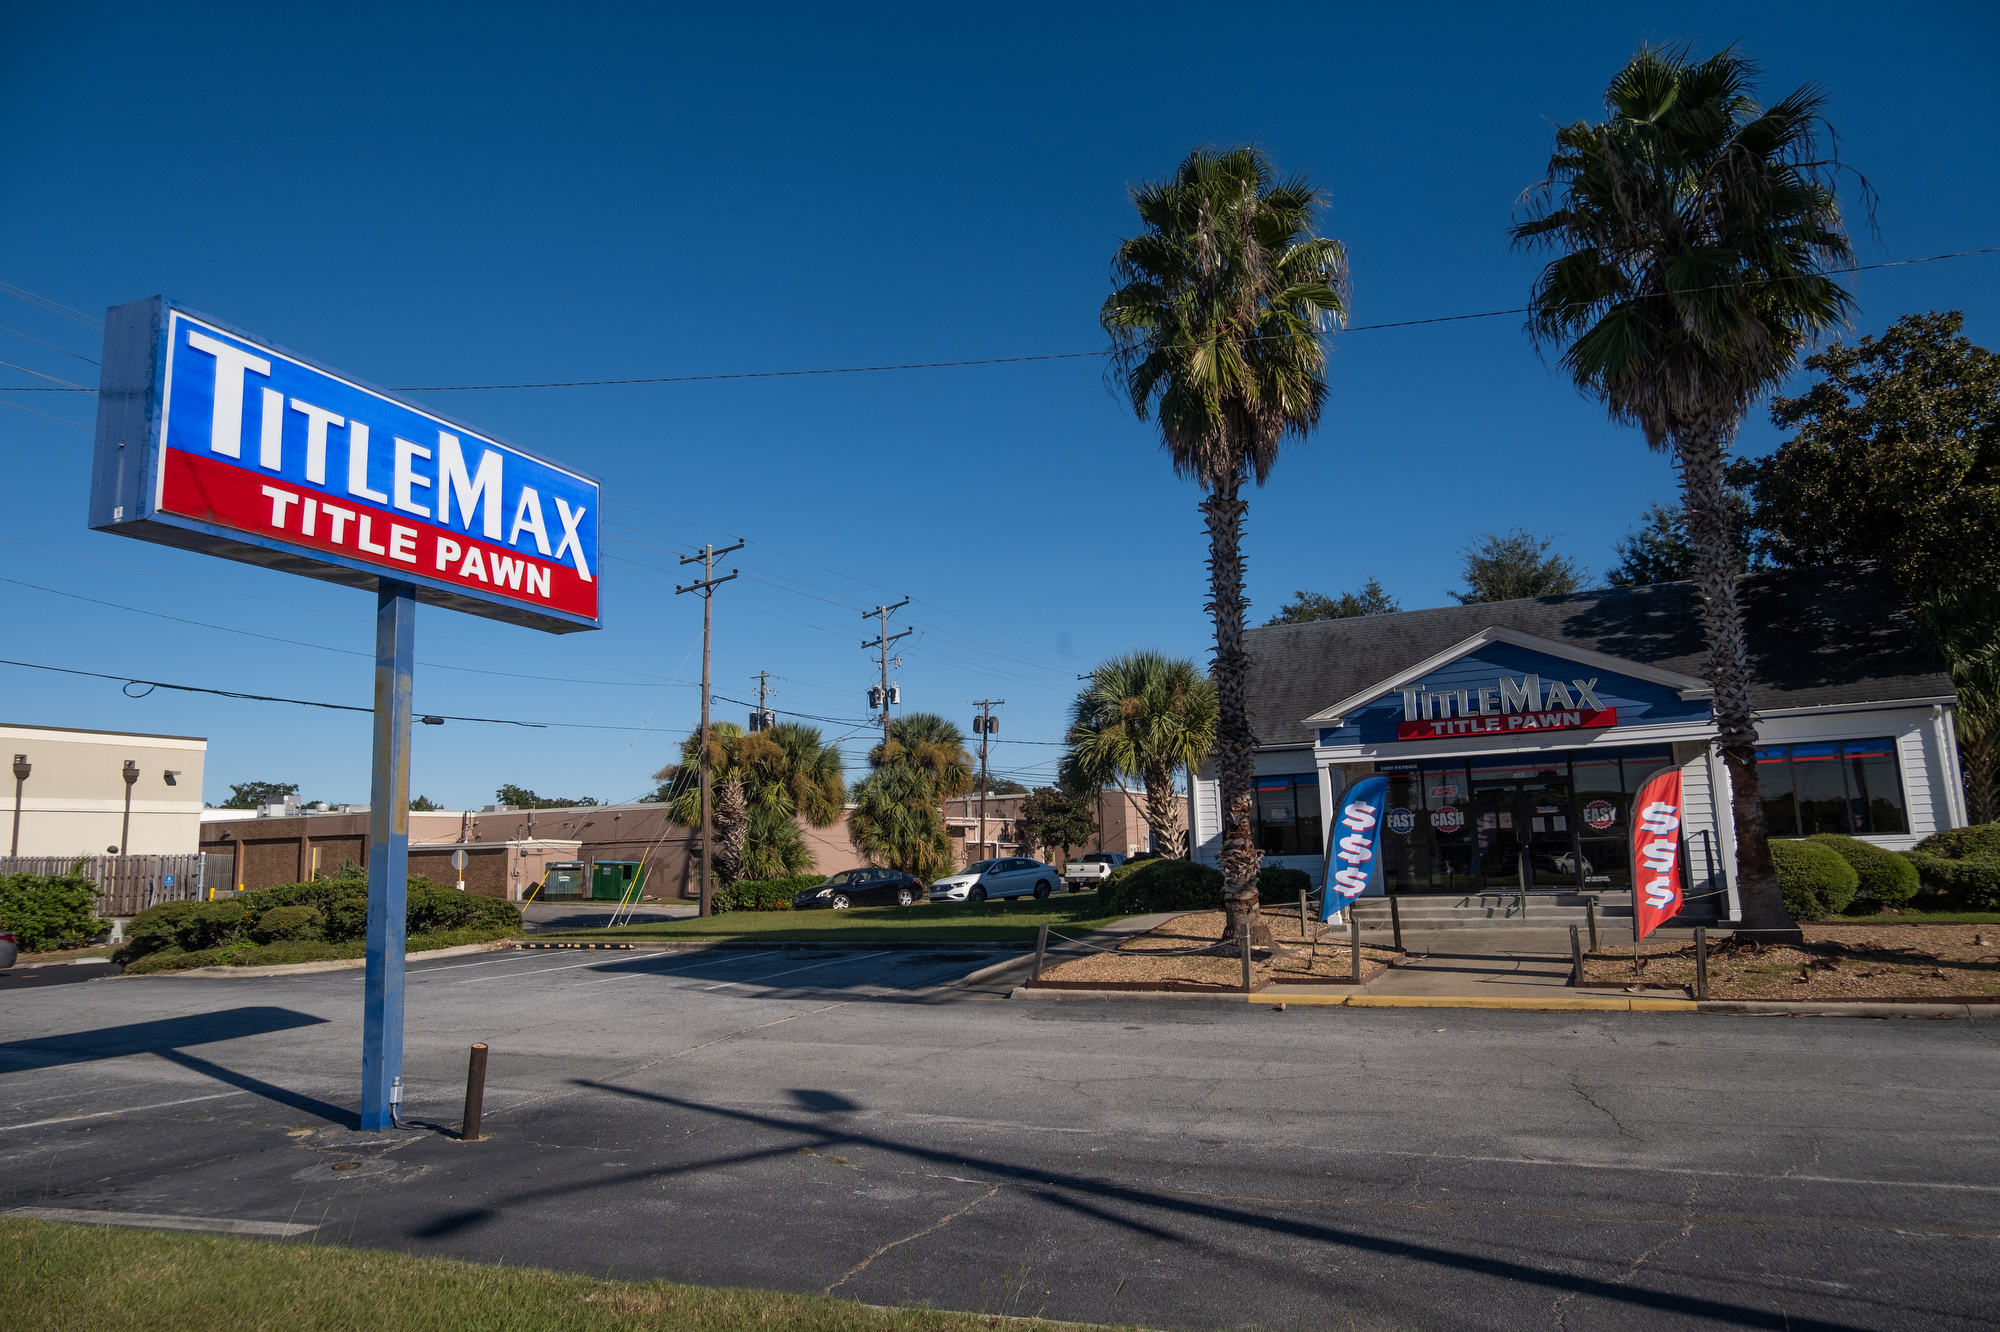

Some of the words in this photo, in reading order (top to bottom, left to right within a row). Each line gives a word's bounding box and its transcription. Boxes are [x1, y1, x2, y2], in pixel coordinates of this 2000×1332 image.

[261, 484, 417, 564] TITLE
[435, 536, 551, 598] PAWN
[1430, 718, 1500, 735] TITLE
[1508, 712, 1581, 730] PAWN
[1429, 786, 1456, 797] OPEN
[1387, 813, 1416, 828] FAST
[1430, 811, 1465, 827] CASH
[1583, 807, 1617, 823] EASY
